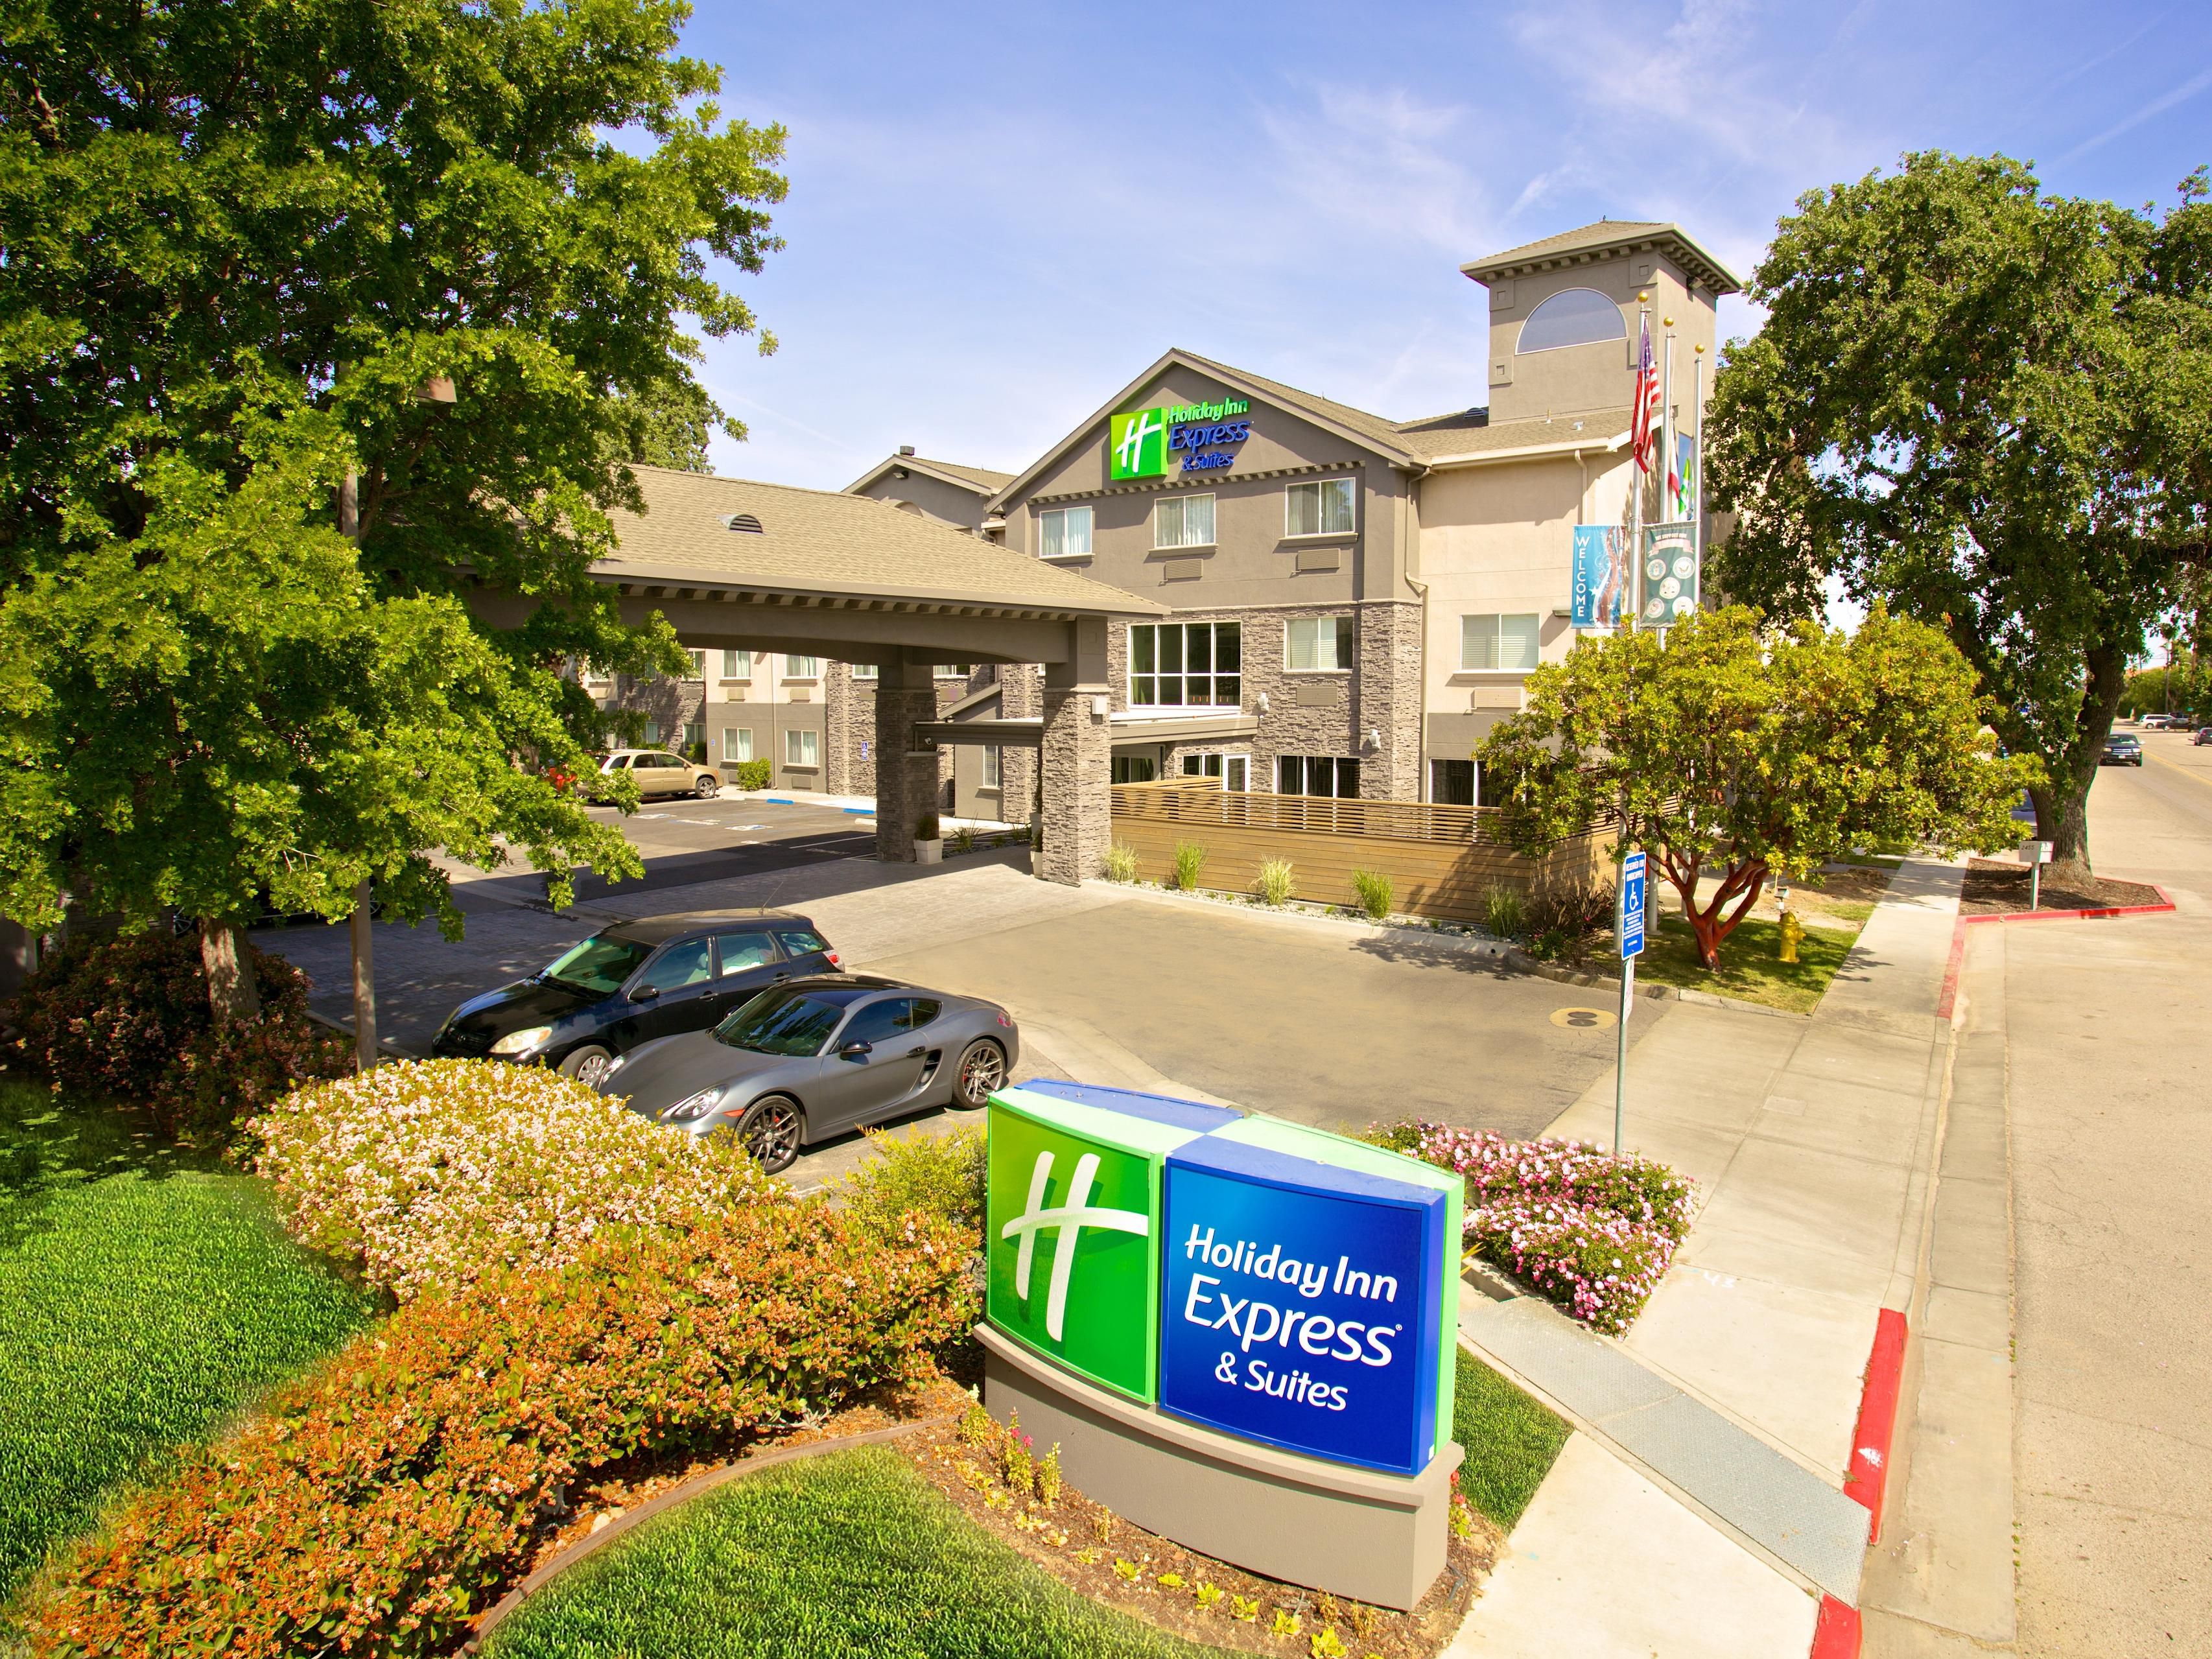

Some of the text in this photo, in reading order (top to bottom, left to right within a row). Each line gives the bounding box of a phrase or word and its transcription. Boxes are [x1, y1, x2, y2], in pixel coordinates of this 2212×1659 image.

[1168, 397, 1248, 423] Holiday Inn
[1169, 420, 1250, 453] Express
[1181, 451, 1234, 471] & Suites
[1576, 536, 1590, 617] WELCOME
[1184, 1223, 1398, 1302] Holiday Inn
[1214, 1351, 1349, 1411] & Suites
